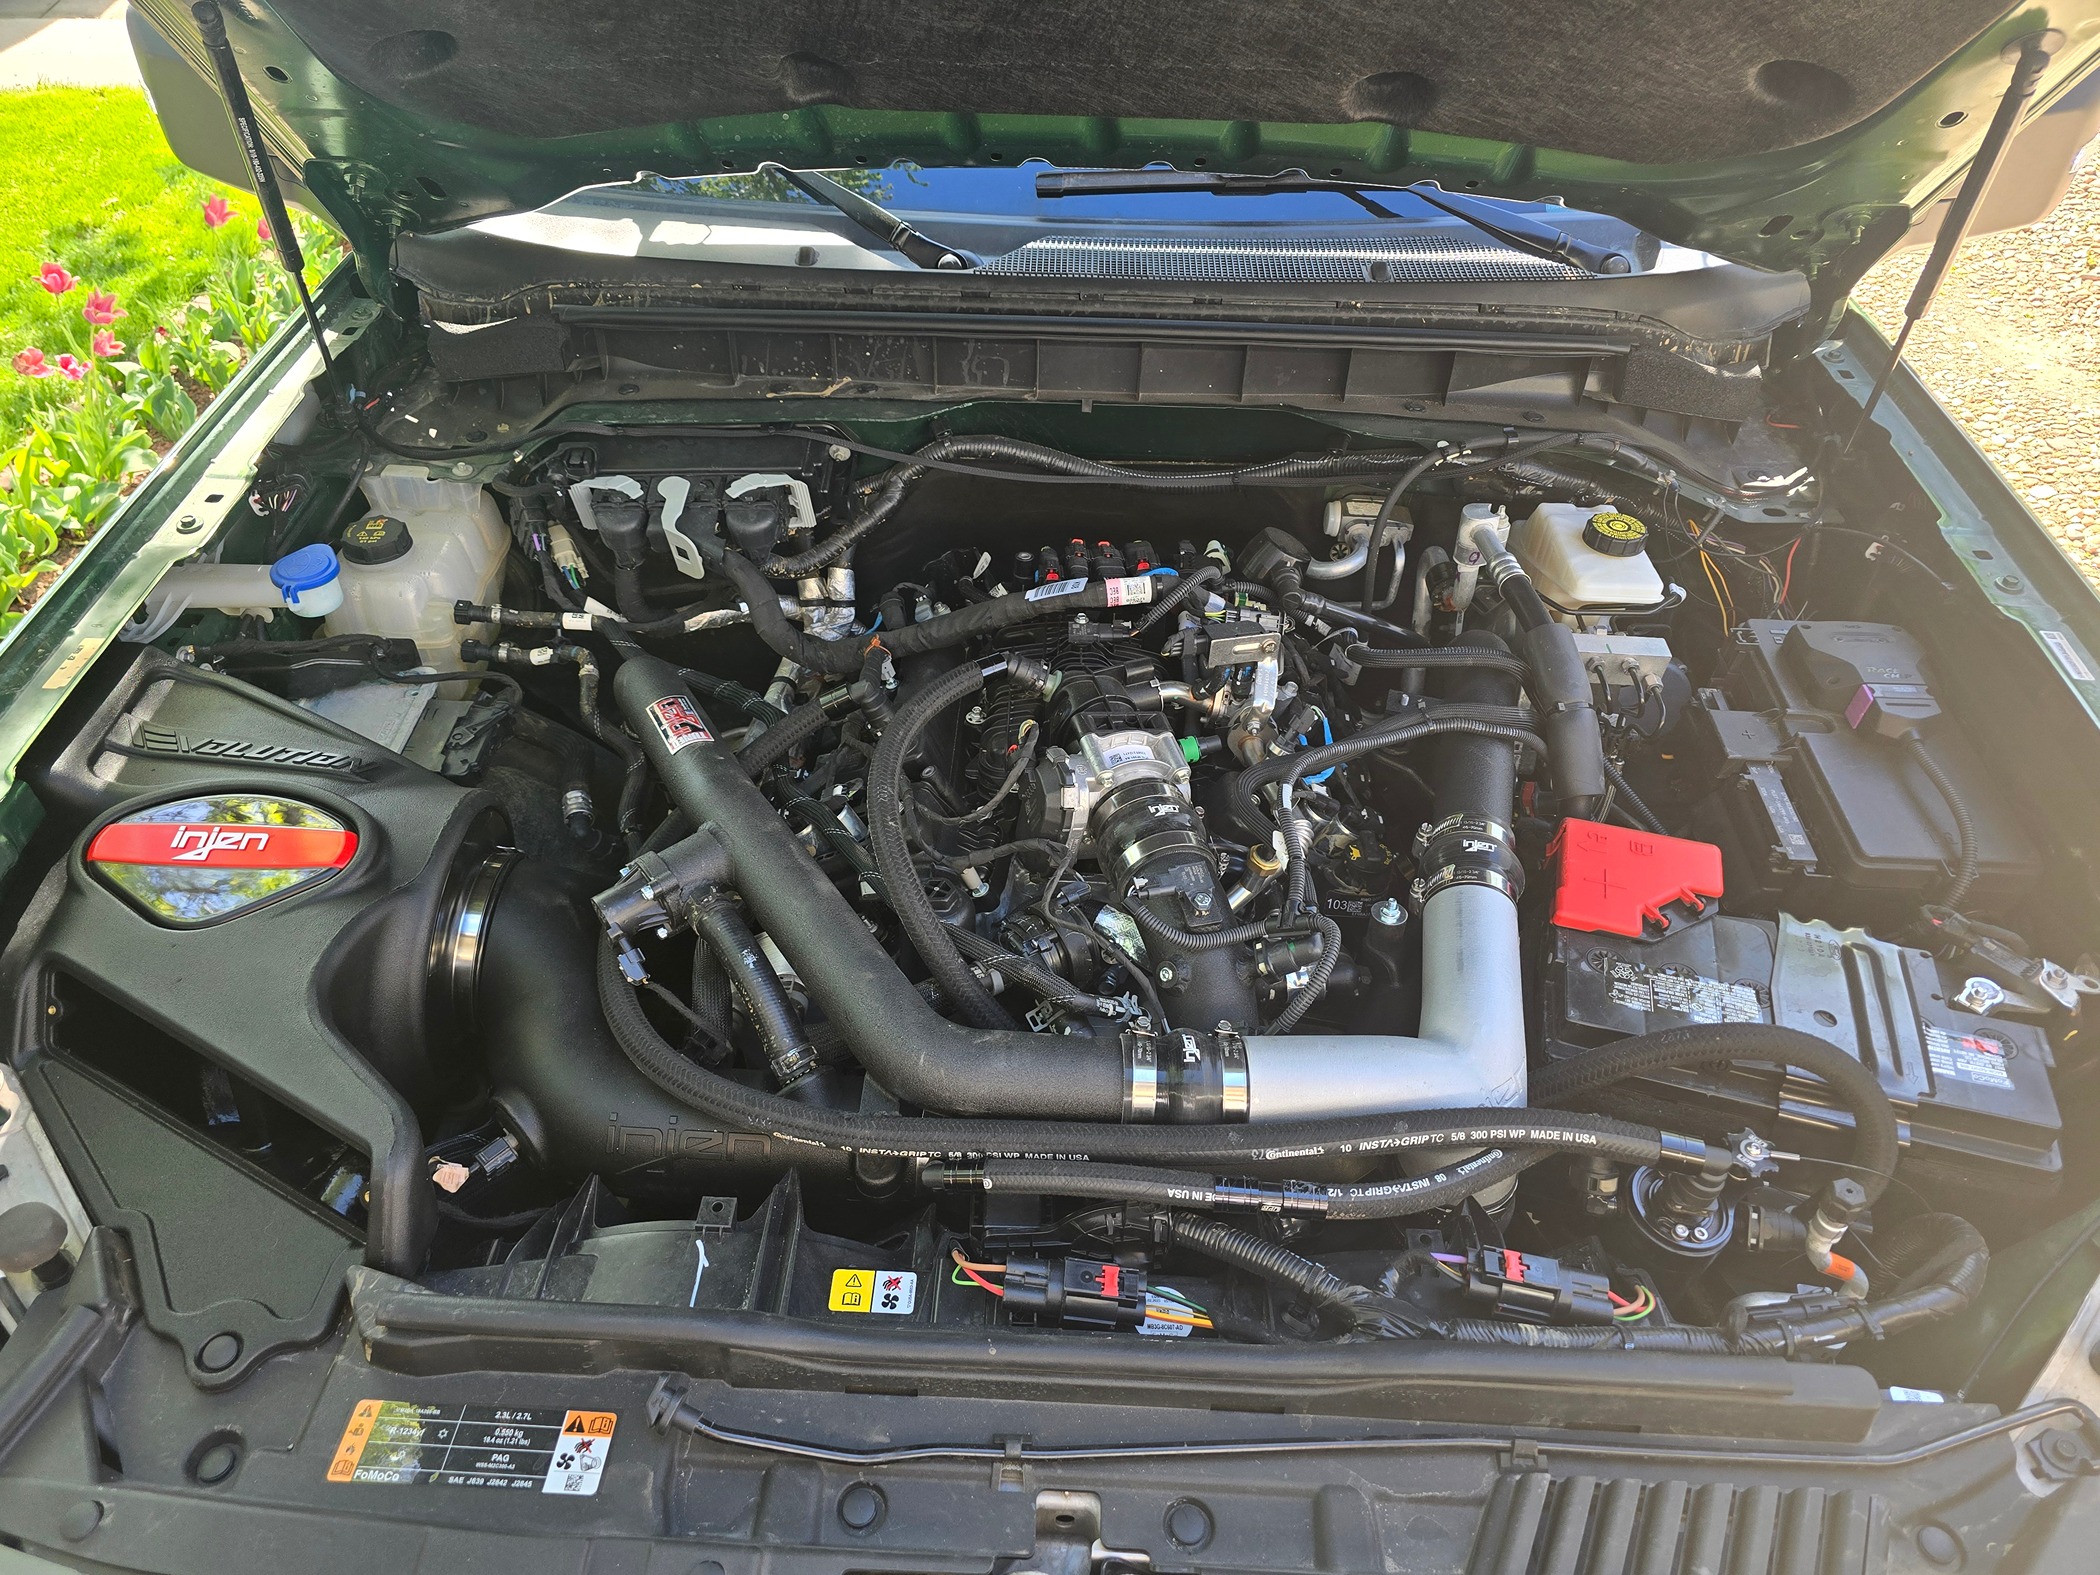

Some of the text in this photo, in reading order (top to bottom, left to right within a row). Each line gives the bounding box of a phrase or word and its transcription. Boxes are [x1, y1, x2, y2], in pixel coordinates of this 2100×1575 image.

[170, 825, 269, 861] injen
[1327, 898, 1348, 910] 103
[605, 1111, 772, 1175] injen
[1266, 1146, 1325, 1160] Continental
[1340, 1144, 1352, 1153] 10
[1430, 1133, 1444, 1143] TC
[1450, 1132, 1466, 1142] 5/8
[1470, 1131, 1488, 1140] 300
[1490, 1130, 1507, 1139] PSI
[1508, 1130, 1526, 1138] WP
[1530, 1130, 1560, 1141] MADE
[1562, 1132, 1574, 1142] IN
[1575, 1134, 1597, 1144] USA
[1456, 1148, 1503, 1176] Continental
[1434, 1173, 1447, 1183] 08
[1167, 1188, 1190, 1200] USA
[1192, 1191, 1203, 1201] IN
[1326, 1188, 1343, 1198] 1/2
[1350, 1188, 1364, 1198] TC
[494, 1410, 511, 1420] 2.3L
[516, 1412, 532, 1421] 2.7L
[389, 1427, 427, 1437] R-1234yf
[494, 1428, 524, 1438] 0.550 kg
[483, 1436, 496, 1444] 19.4
[491, 1454, 510, 1462] PAG
[353, 1469, 400, 1481] FoMoCo
[448, 1476, 464, 1484] SAE
